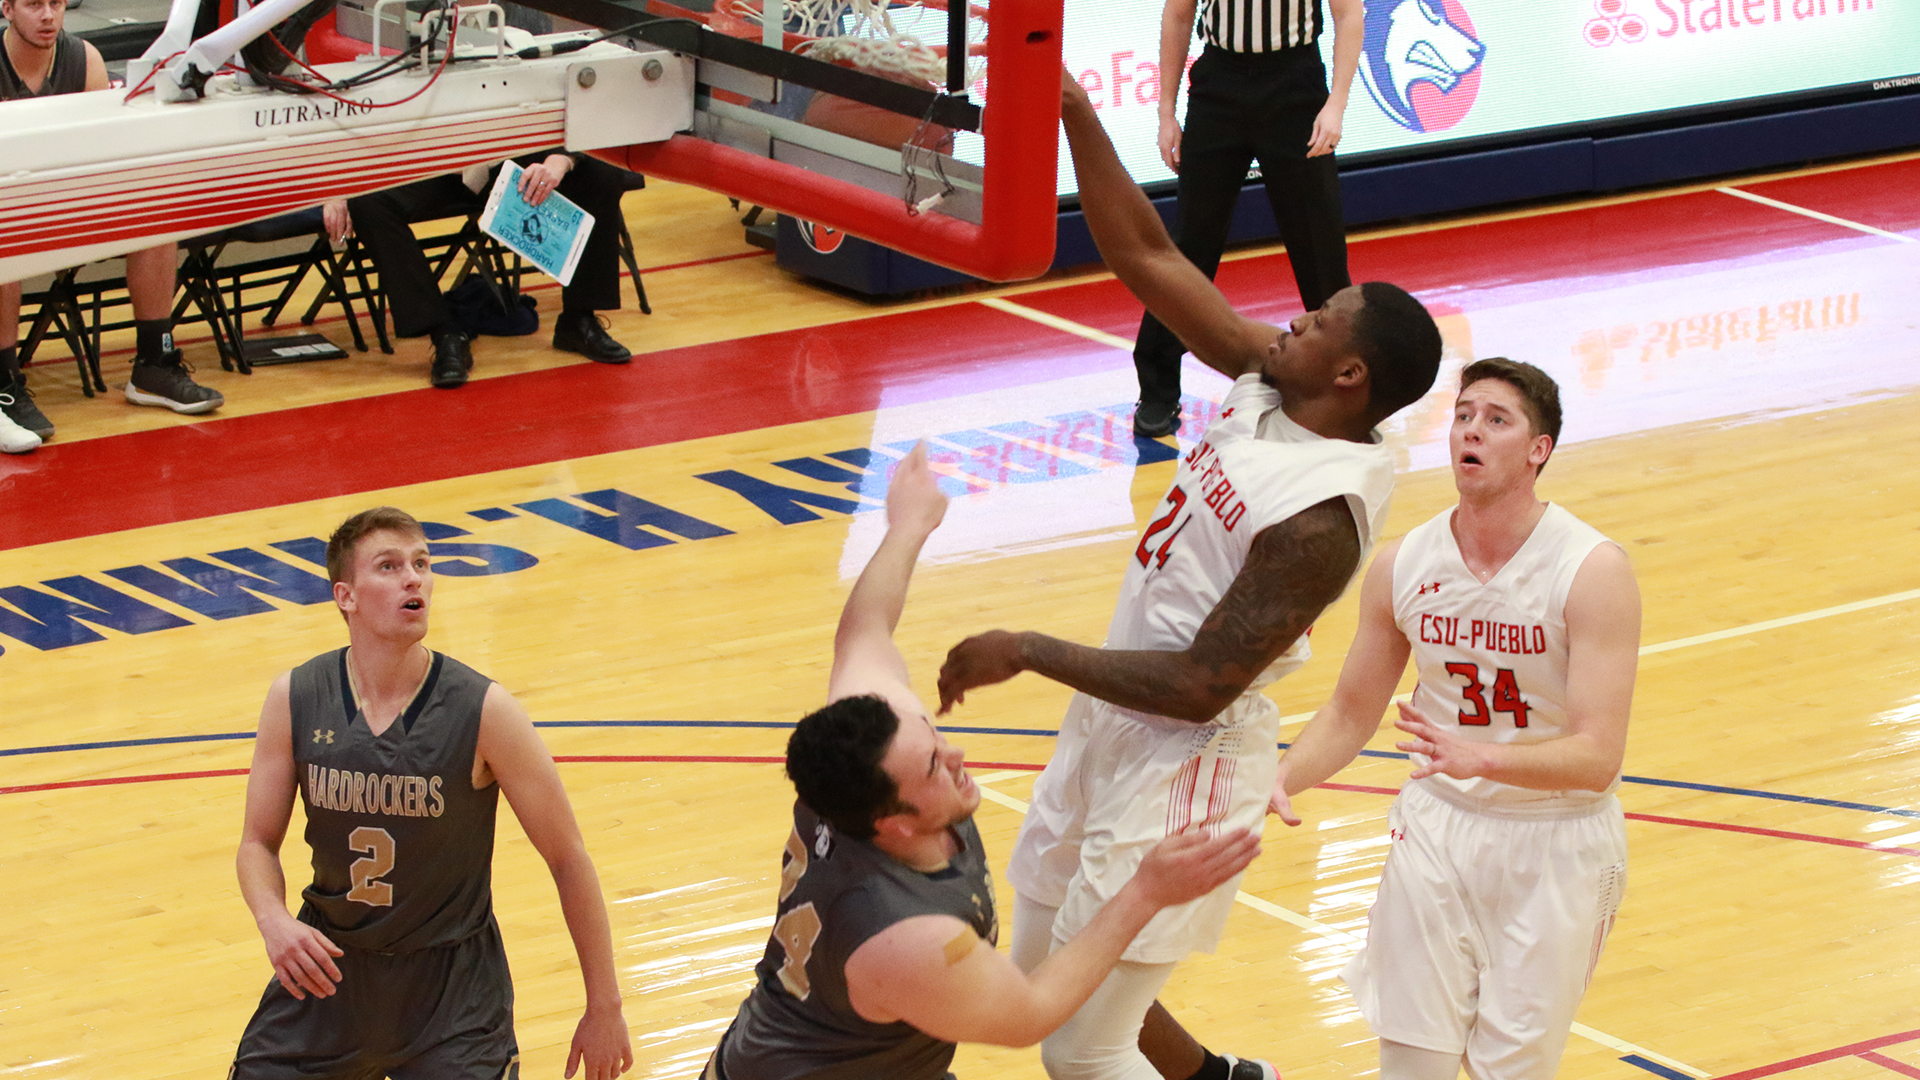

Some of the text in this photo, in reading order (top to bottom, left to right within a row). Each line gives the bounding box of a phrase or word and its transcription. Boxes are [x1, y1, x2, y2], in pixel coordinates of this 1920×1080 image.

[255, 97, 373, 128] ULTRA-PRO
[498, 225, 554, 269] HARDROCKER
[1420, 613, 1547, 655] CSU-PUEBLO
[1445, 661, 1533, 728] 34
[308, 763, 445, 818] HARDROCKERS
[346, 826, 396, 907] 2
